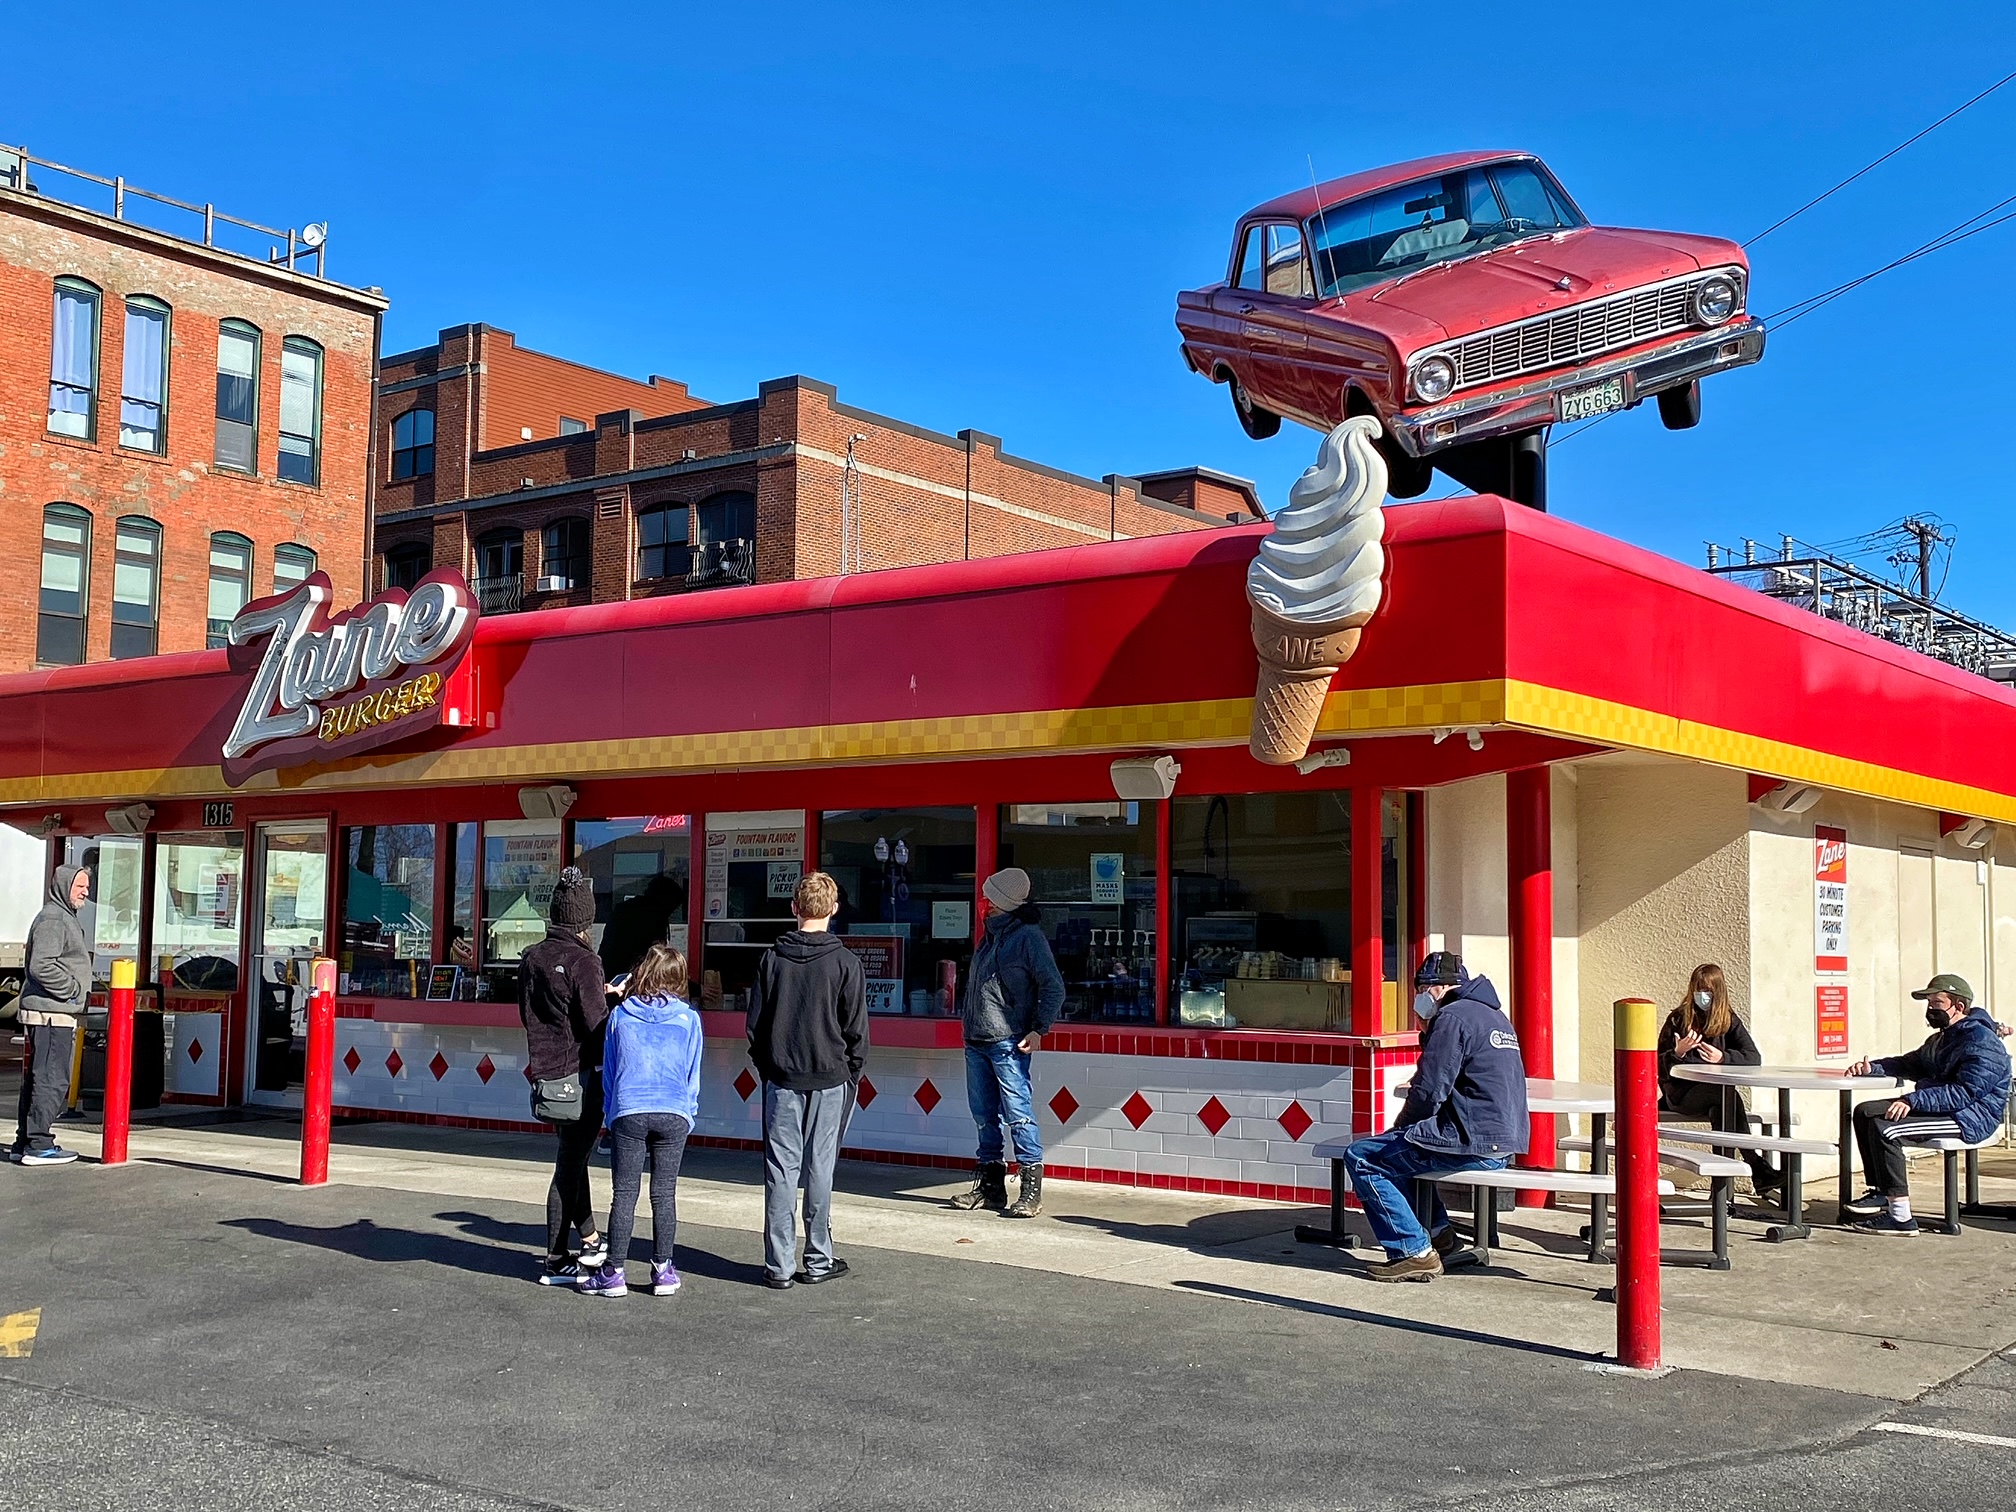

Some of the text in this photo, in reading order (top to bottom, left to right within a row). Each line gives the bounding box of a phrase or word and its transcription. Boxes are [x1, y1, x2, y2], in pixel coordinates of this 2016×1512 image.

[1564, 396, 1592, 417] ZYG
[1595, 388, 1621, 408] 663
[222, 582, 470, 759] Zane
[318, 671, 442, 742] BURGER
[204, 803, 233, 826] 1315
[506, 839, 558, 851] FOUNTAIN FLAVORS
[736, 832, 797, 845] FOUNTAIN FLAVORS
[1816, 838, 1846, 876] Zane
[532, 884, 555, 894] ORDER
[773, 883, 794, 893] HERE
[1819, 885, 1845, 901] 30 MINUTE
[534, 894, 552, 903] HERE
[1819, 902, 1844, 918] CUSTOMER
[1821, 920, 1842, 935] PARKING
[1825, 937, 1838, 951] ONLY
[866, 982, 896, 994] PICKUP
[865, 994, 878, 1008] RE
